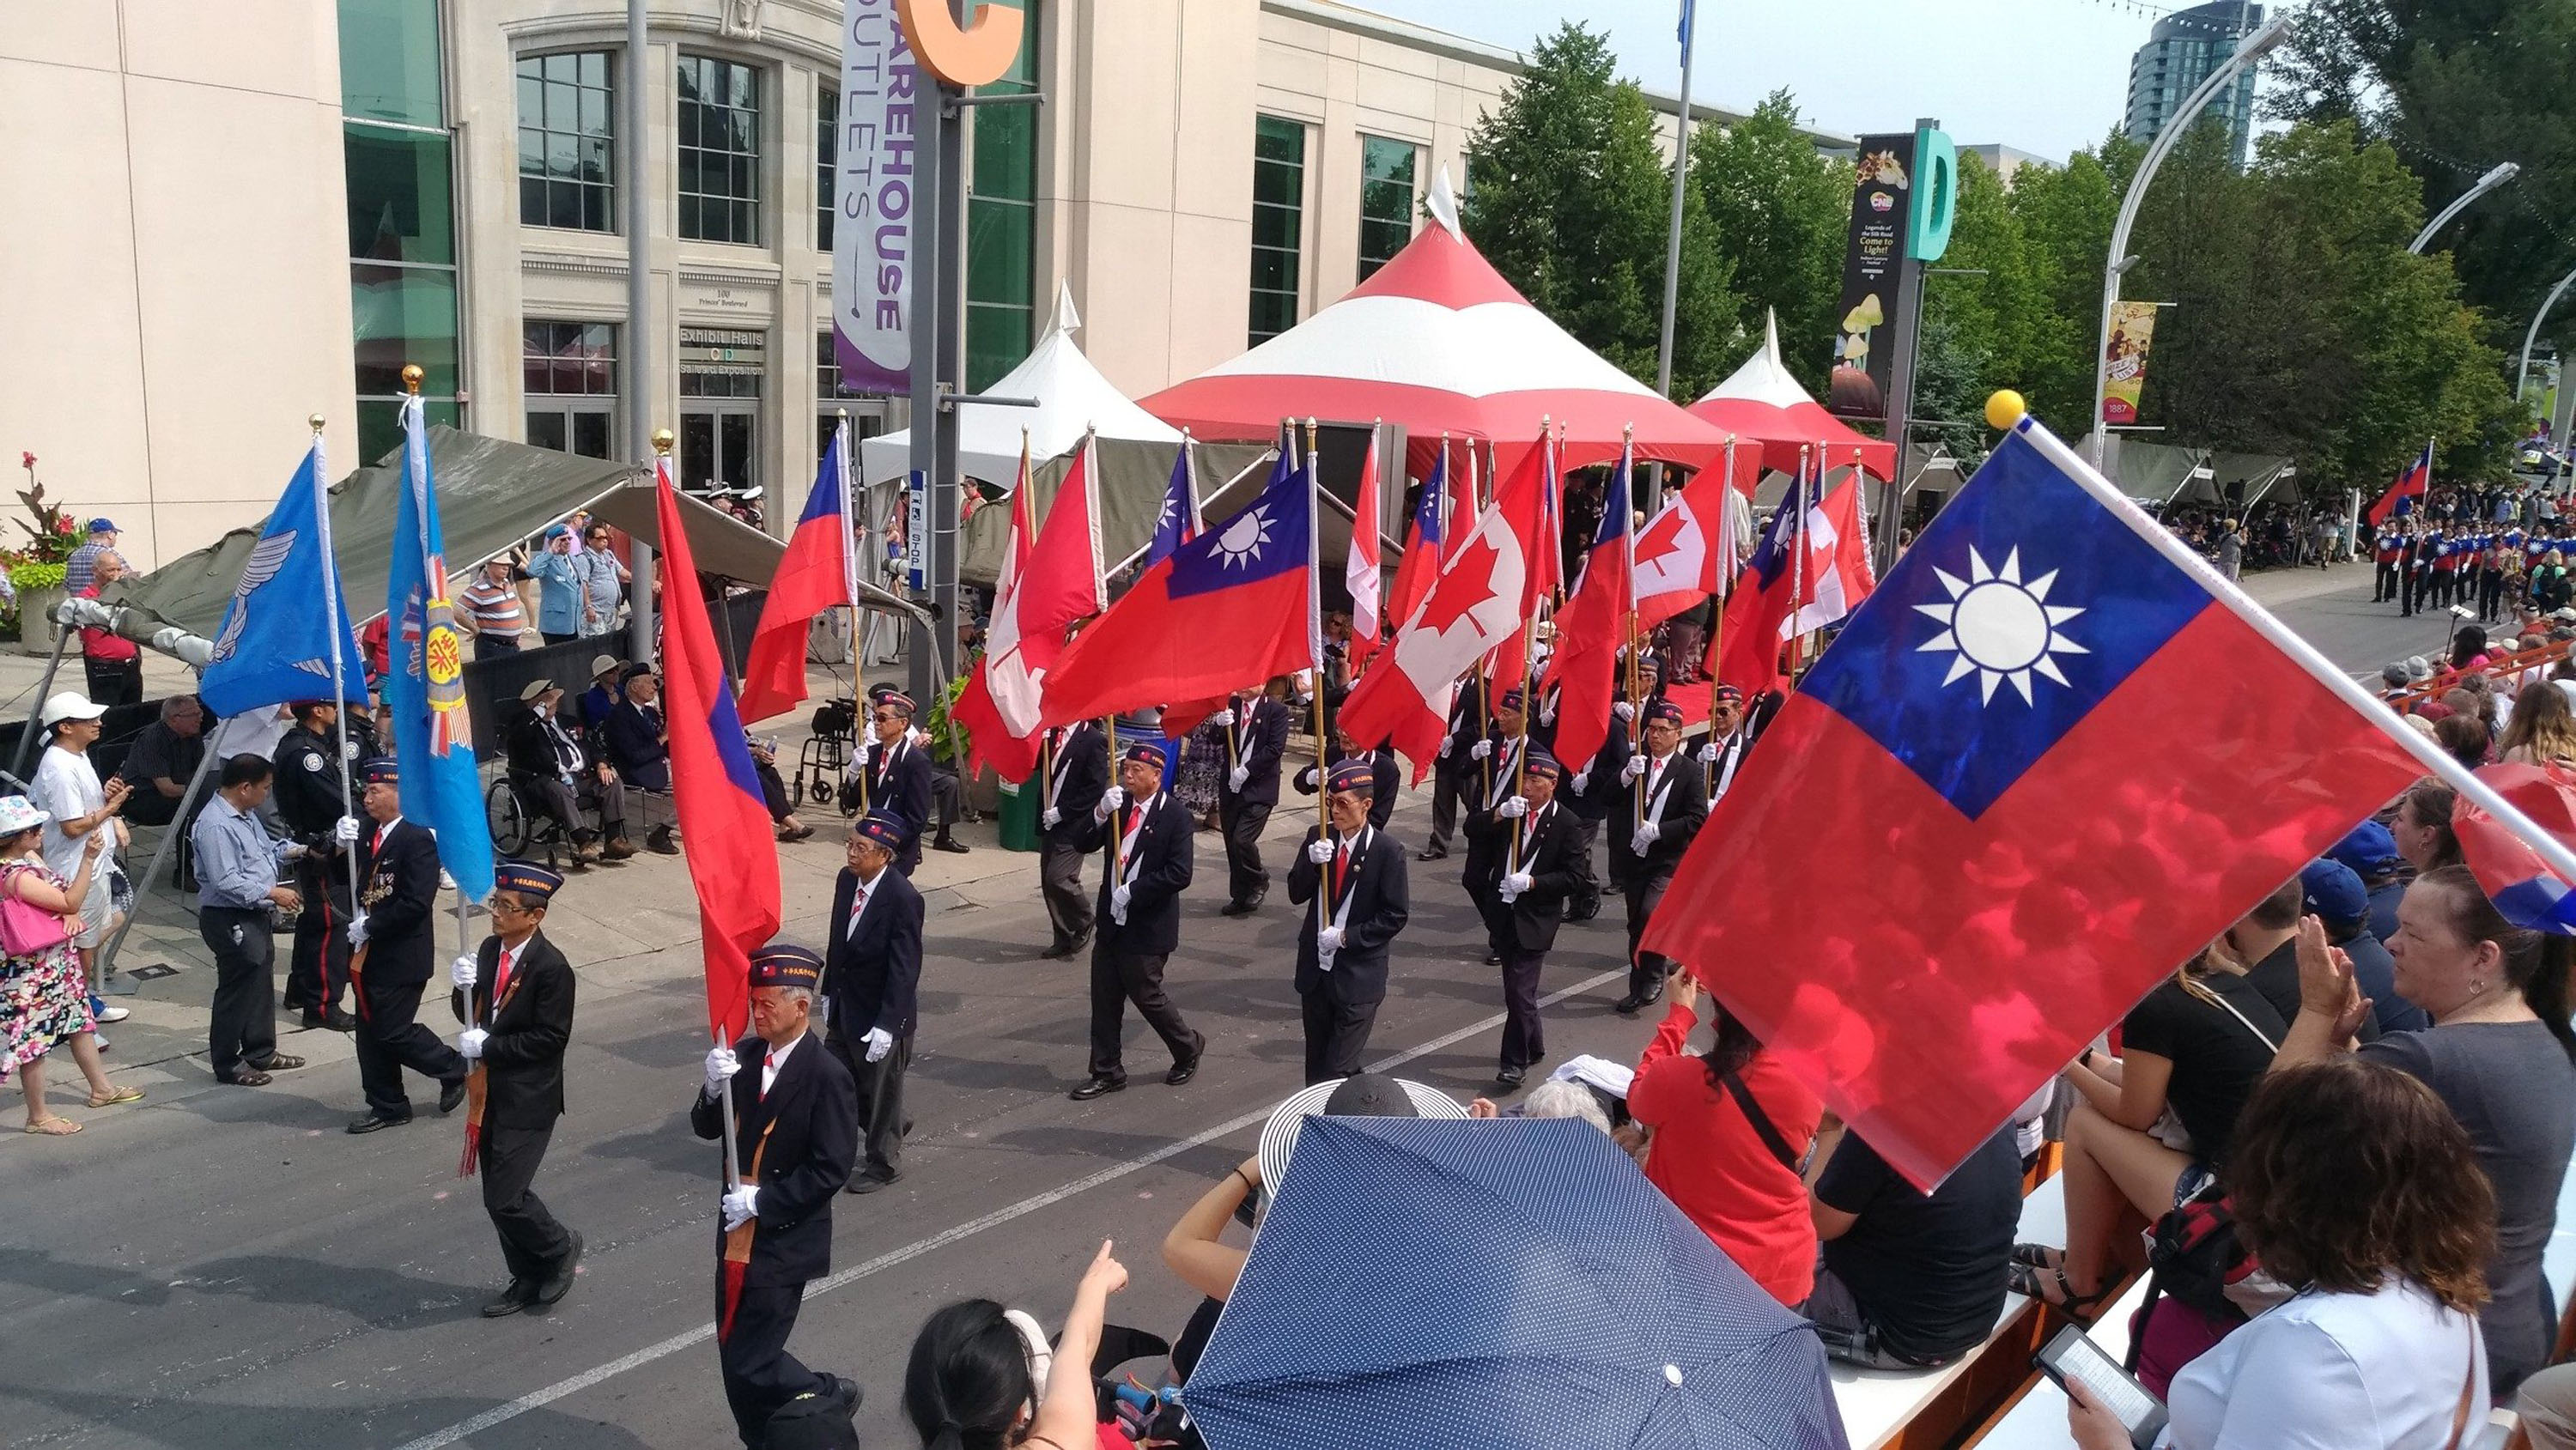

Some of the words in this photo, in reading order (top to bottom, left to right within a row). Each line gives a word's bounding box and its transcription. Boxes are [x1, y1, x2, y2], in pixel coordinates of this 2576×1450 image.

[846, 0, 882, 220] UTLETS
[876, 0, 916, 331] AREHOUSE
[1907, 128, 1957, 261] D
[1860, 237, 1883, 246] Come
[1864, 246, 1888, 255] Light!
[717, 289, 731, 299] 100
[680, 329, 727, 343] Exhibit
[731, 331, 762, 345] Halls
[710, 348, 720, 361] C
[725, 349, 733, 361] D
[680, 364, 706, 374] Salles
[2117, 367, 2136, 379] LIST
[2109, 404, 2127, 413] 1887
[911, 534, 920, 567] STOP
